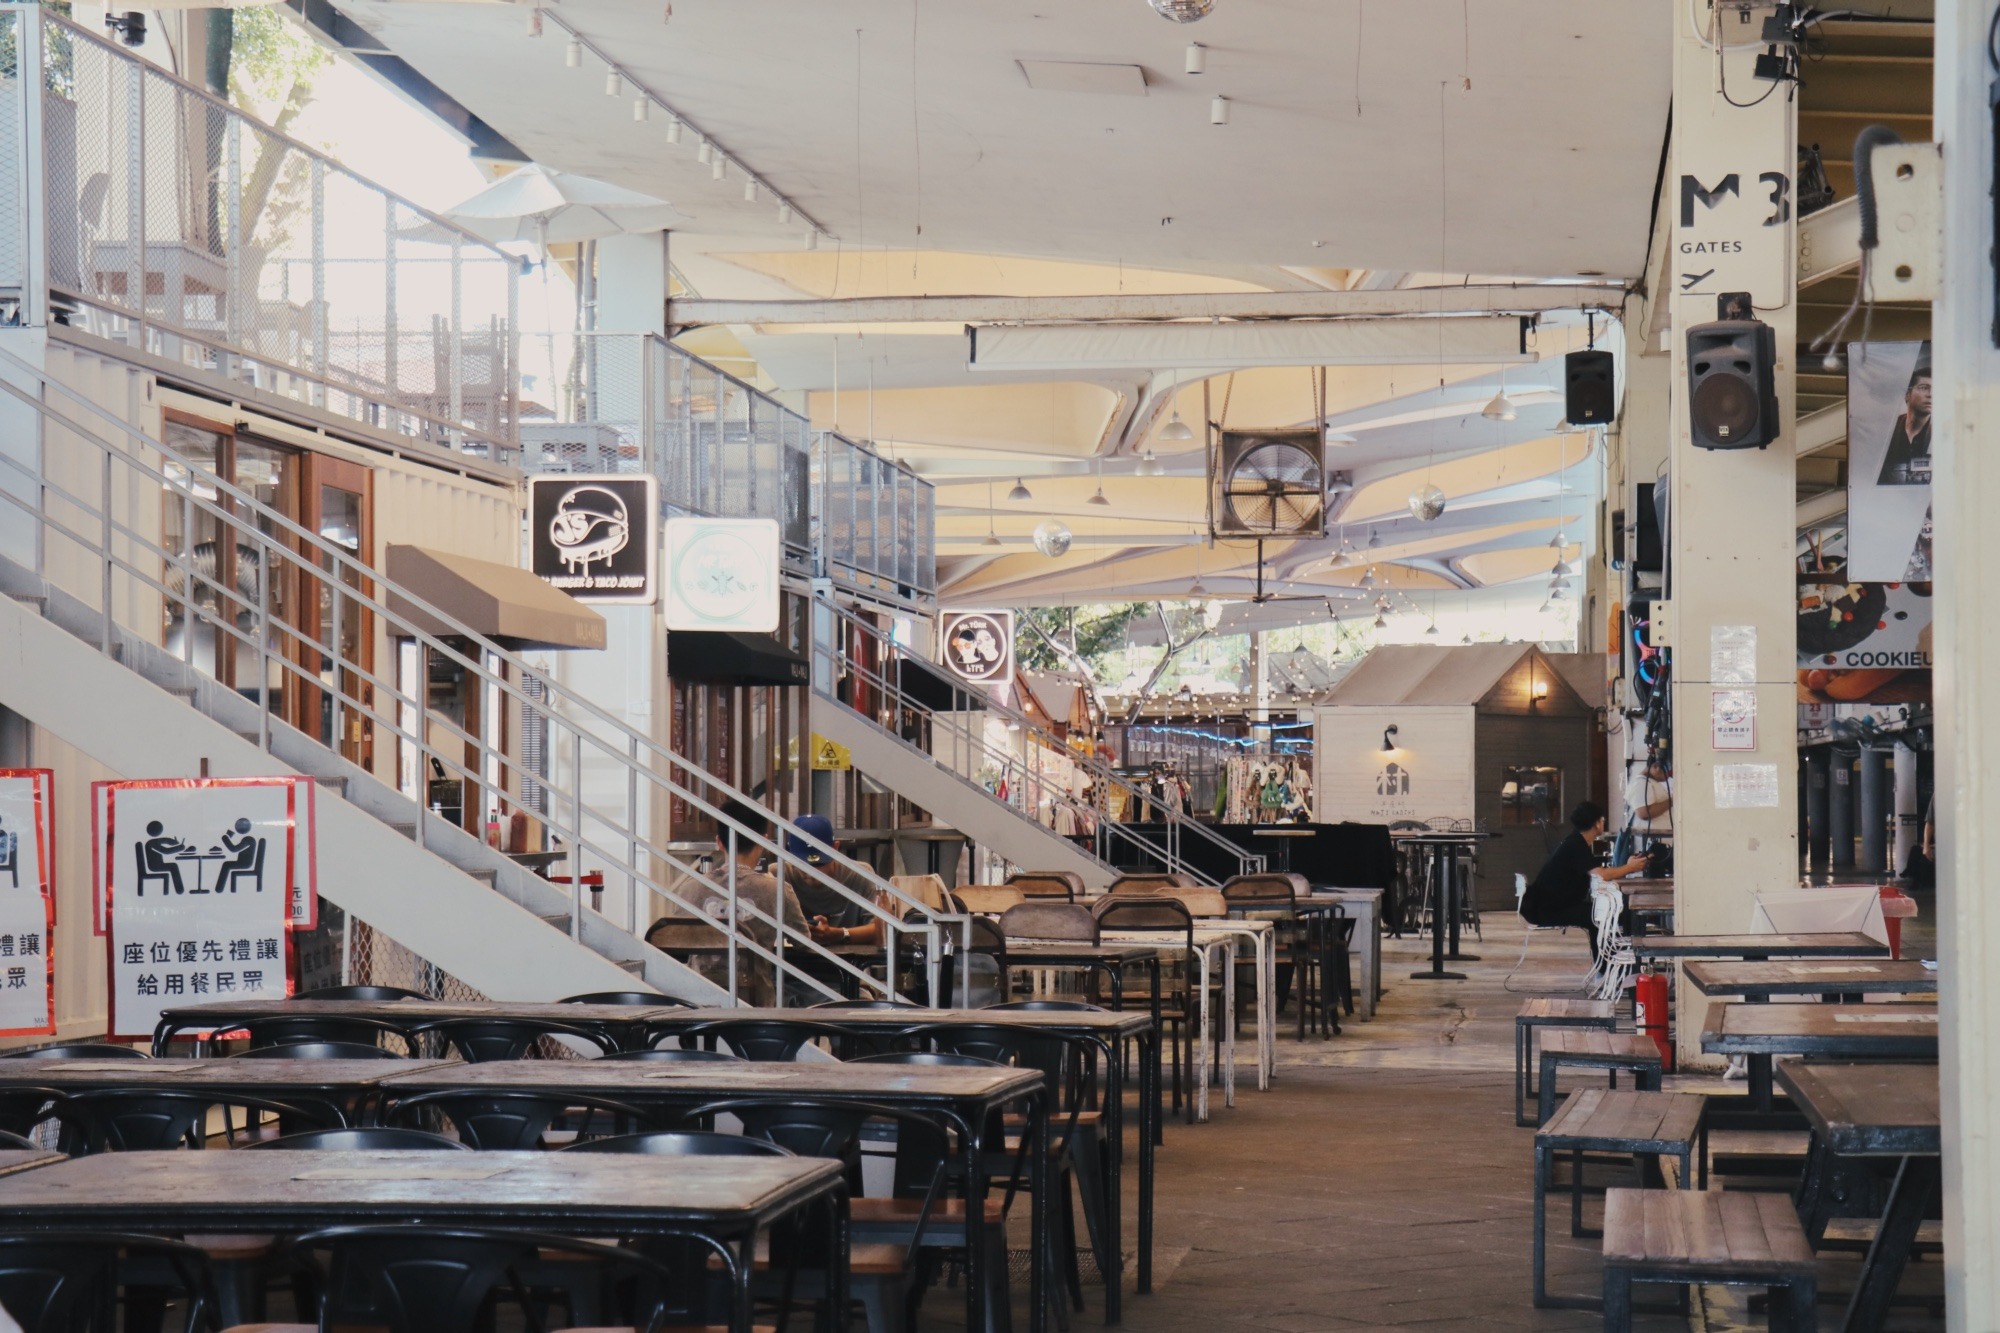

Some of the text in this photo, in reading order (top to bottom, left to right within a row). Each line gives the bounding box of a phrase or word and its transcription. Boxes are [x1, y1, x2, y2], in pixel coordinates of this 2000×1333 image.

[1679, 241, 1743, 255] GATES
[123, 937, 279, 964] 座位優先禮讓
[136, 969, 265, 997] 給用餐民眾
